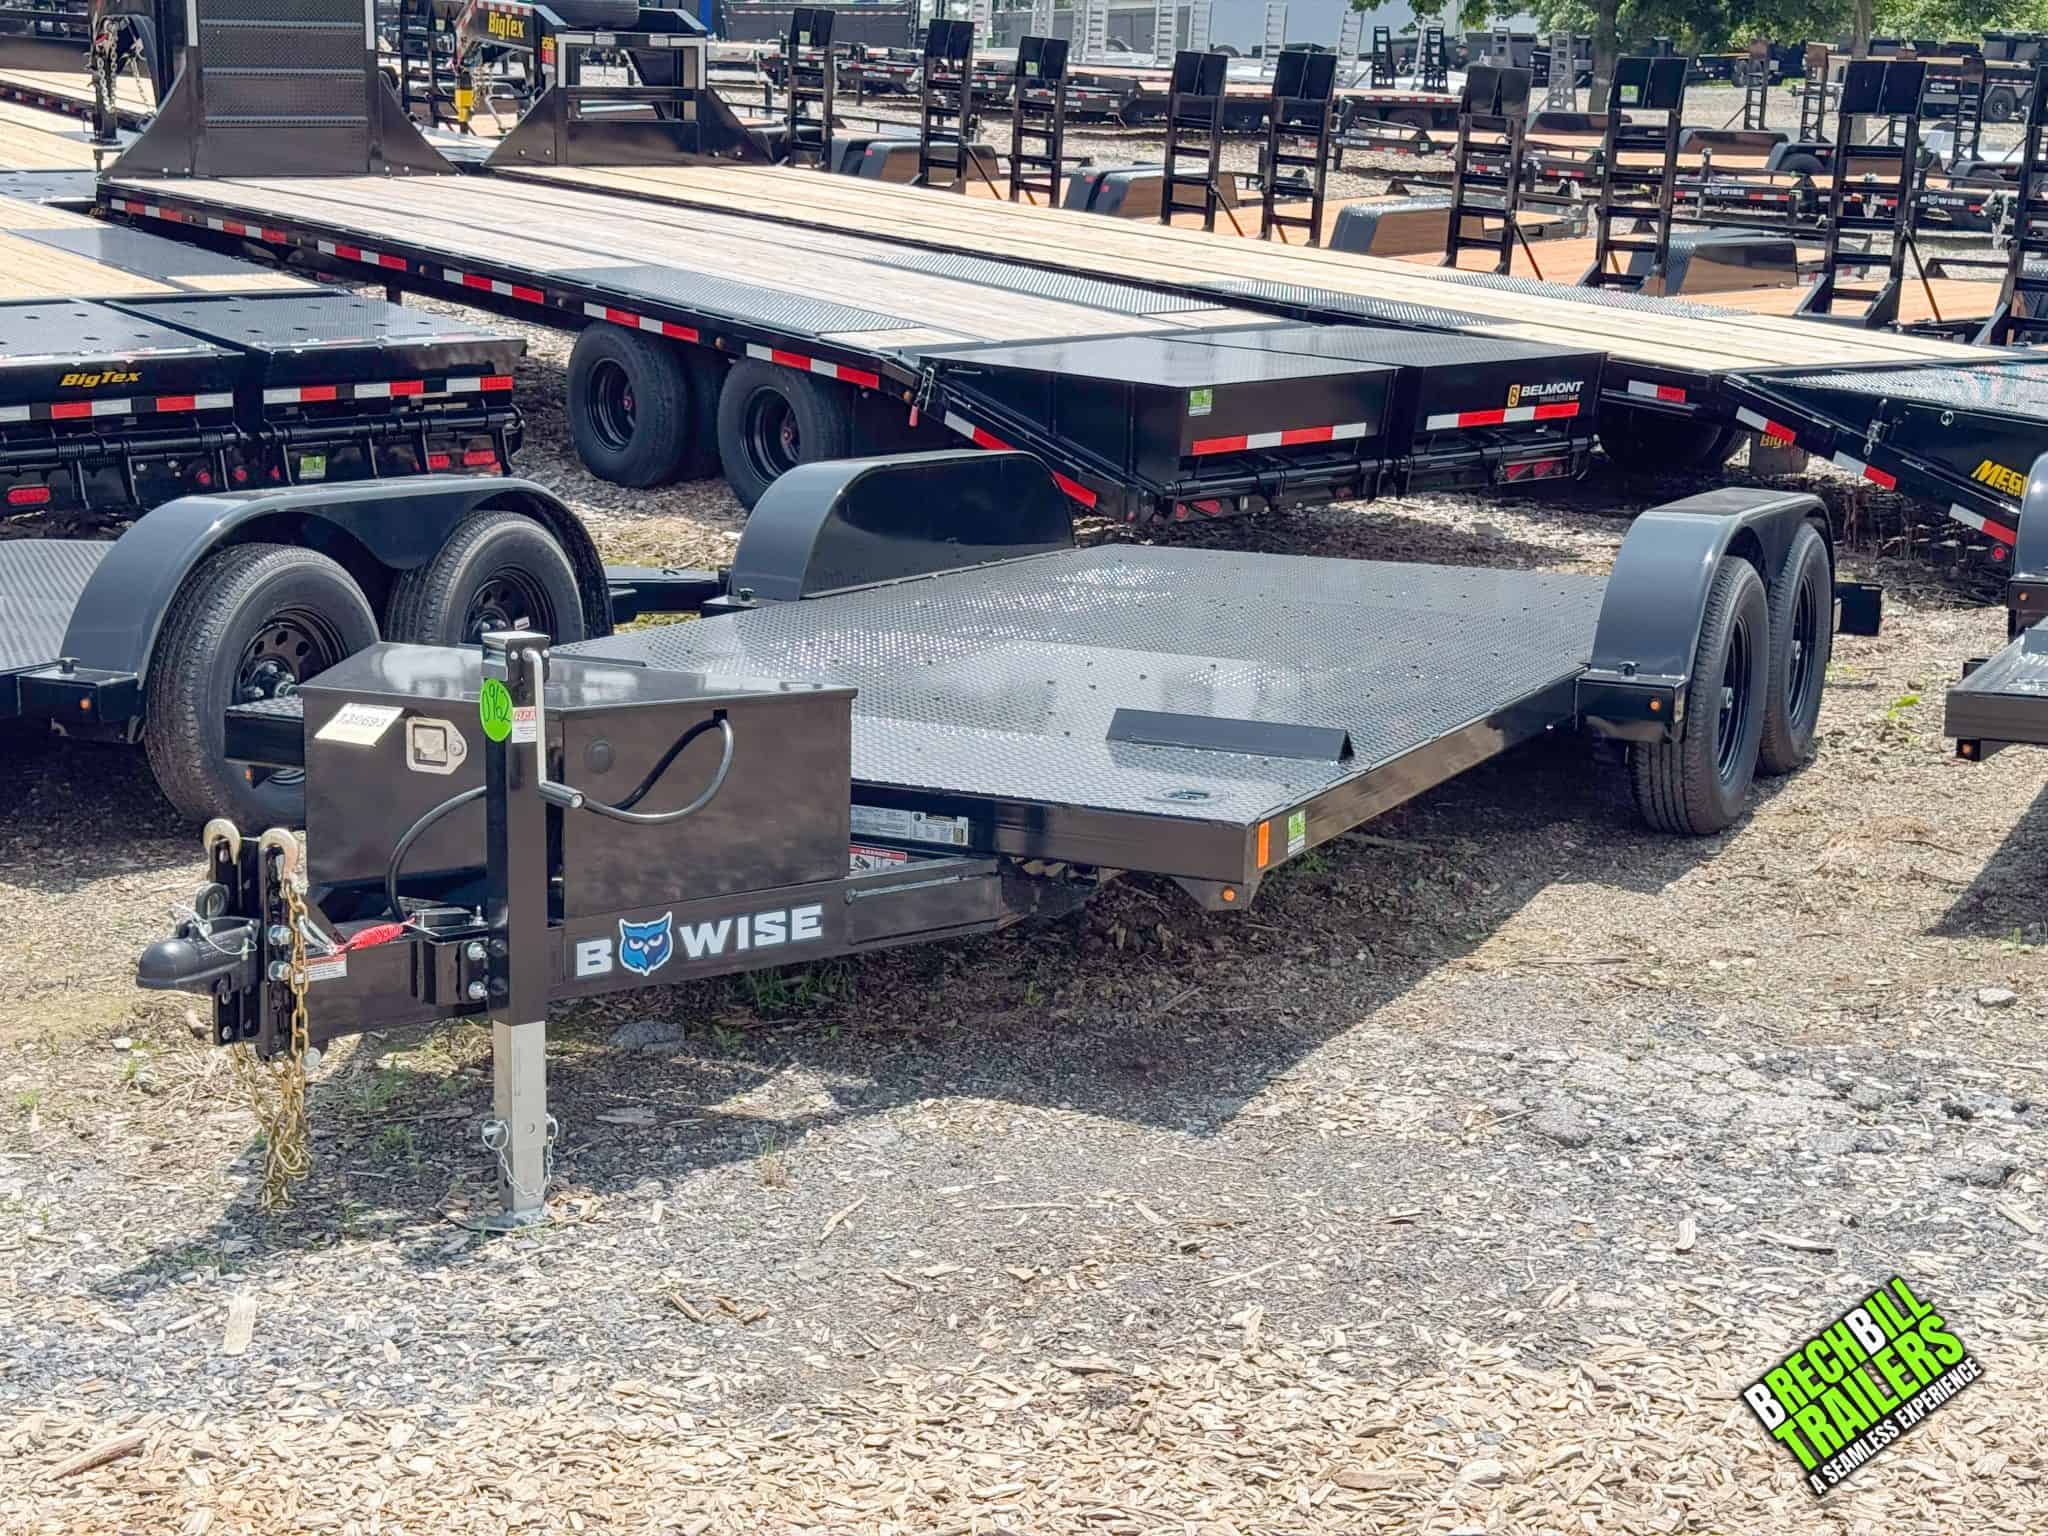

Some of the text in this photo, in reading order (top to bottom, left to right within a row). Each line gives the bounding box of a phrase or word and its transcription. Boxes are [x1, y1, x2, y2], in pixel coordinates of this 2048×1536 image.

[487, 11, 525, 40] BigTex
[60, 371, 143, 388] BigTex
[1520, 381, 1584, 397] BELMONT
[680, 905, 822, 958] WISE
